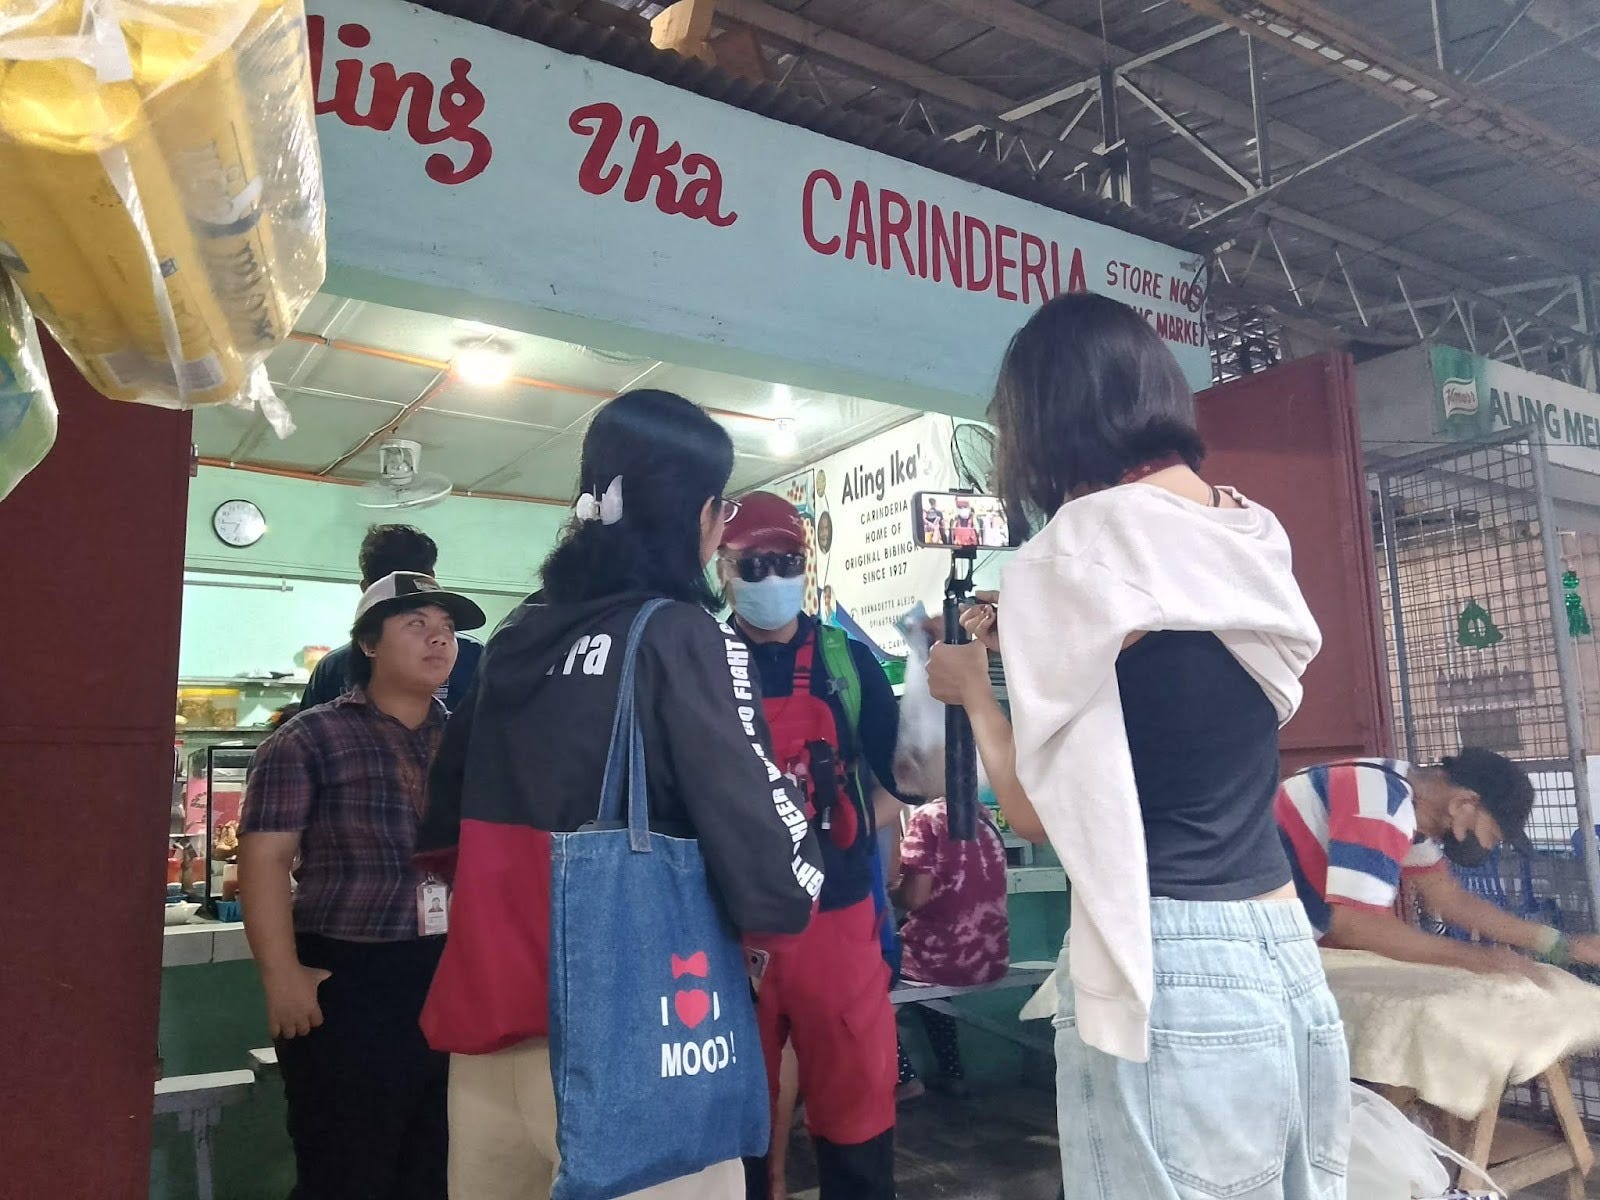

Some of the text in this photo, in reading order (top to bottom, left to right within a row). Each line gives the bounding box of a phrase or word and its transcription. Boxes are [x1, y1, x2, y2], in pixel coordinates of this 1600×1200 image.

[307, 14, 738, 227] ling Ika
[802, 168, 1088, 305] CARINDERIA
[1106, 260, 1164, 300] STORE
[1156, 312, 1207, 347] MARKET
[1489, 387, 1562, 440] ALING
[841, 443, 932, 505] Aling Ika'
[860, 499, 908, 525] CARINDERIA
[865, 522, 902, 544] HOME OF
[845, 540, 919, 571] ORIGINAL BIBING
[862, 561, 907, 584] SINCE 1927
[545, 633, 612, 676] ra
[725, 638, 753, 700] FIGHT
[772, 787, 808, 855] HEER
[660, 996, 669, 1026] I
